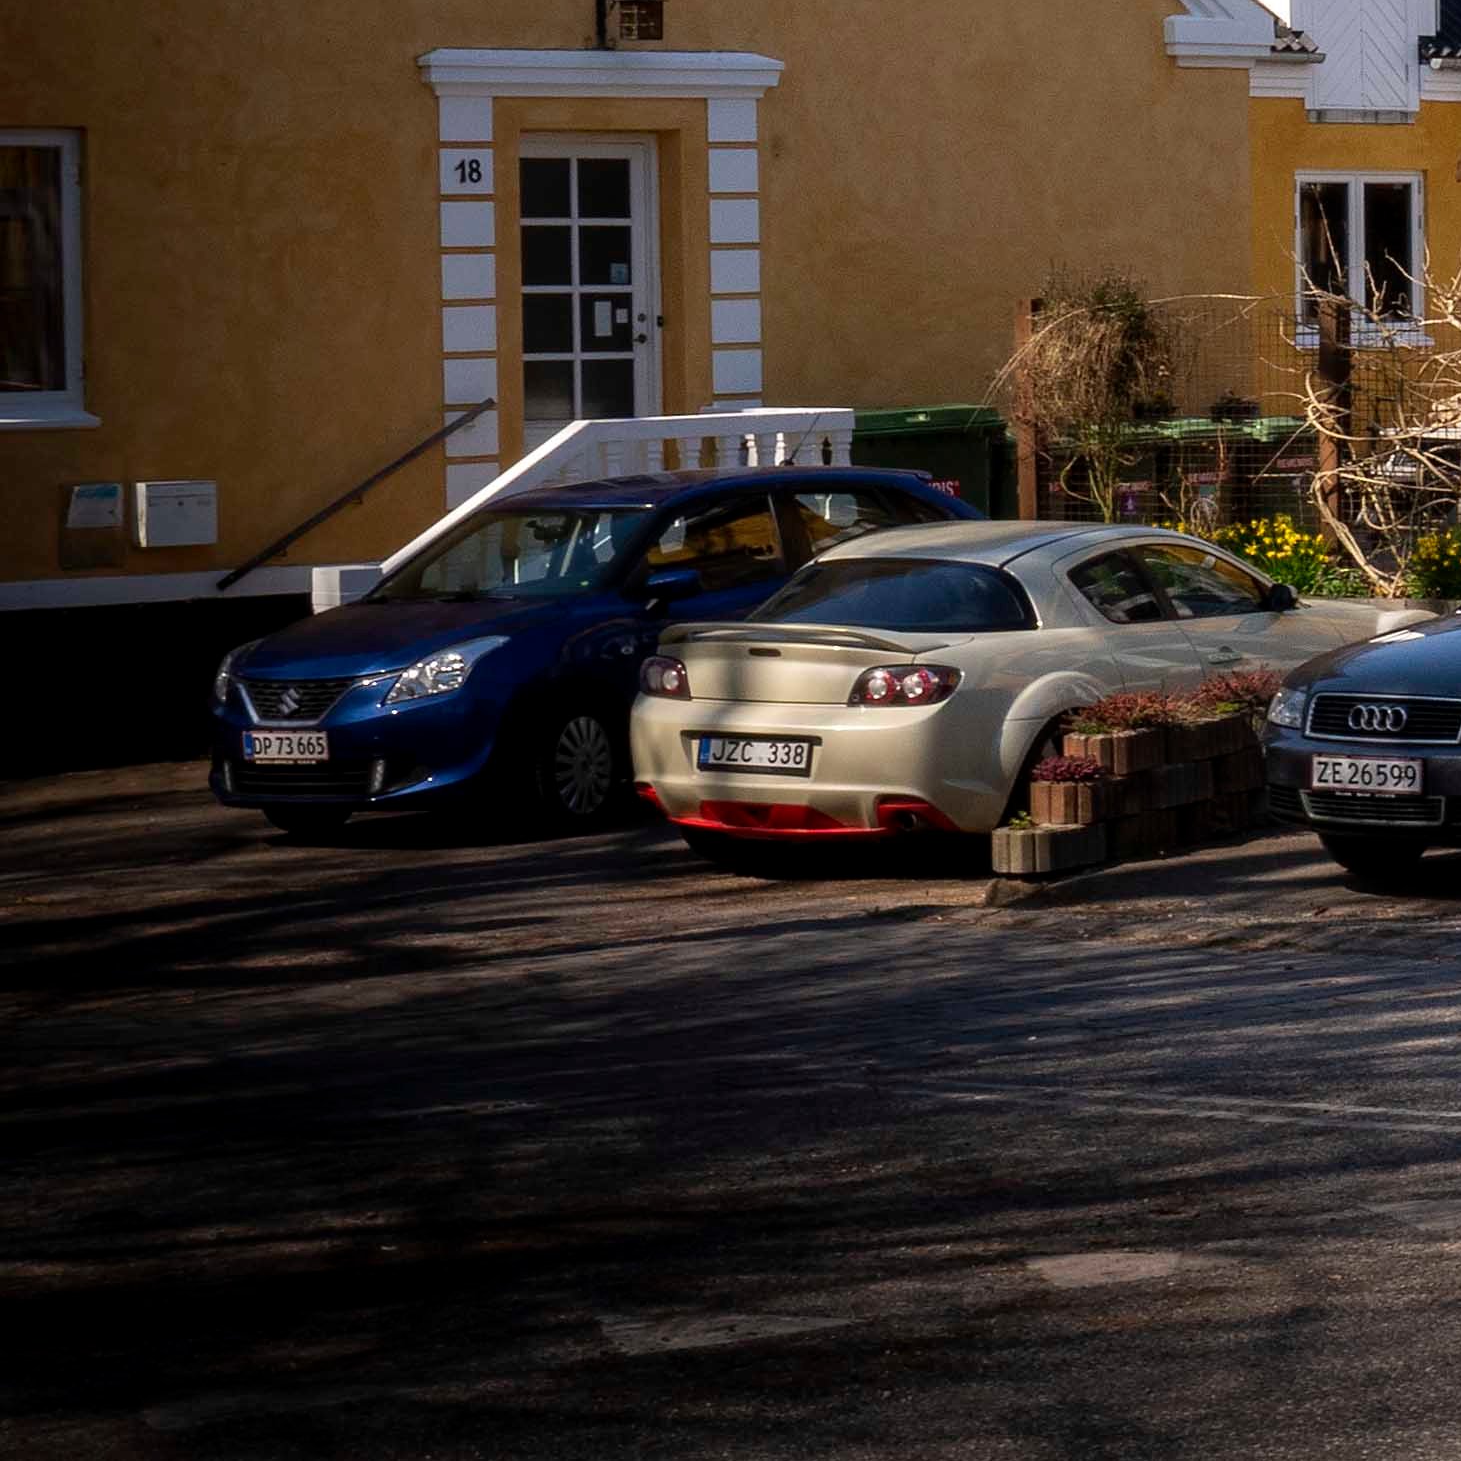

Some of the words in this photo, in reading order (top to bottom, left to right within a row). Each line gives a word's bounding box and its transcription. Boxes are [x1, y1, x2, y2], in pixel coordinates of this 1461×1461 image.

[454, 158, 483, 184] 18
[254, 736, 272, 756] DP
[275, 736, 294, 756] 73
[297, 736, 325, 756] 665
[712, 738, 754, 763] JZC
[767, 742, 805, 765] 338
